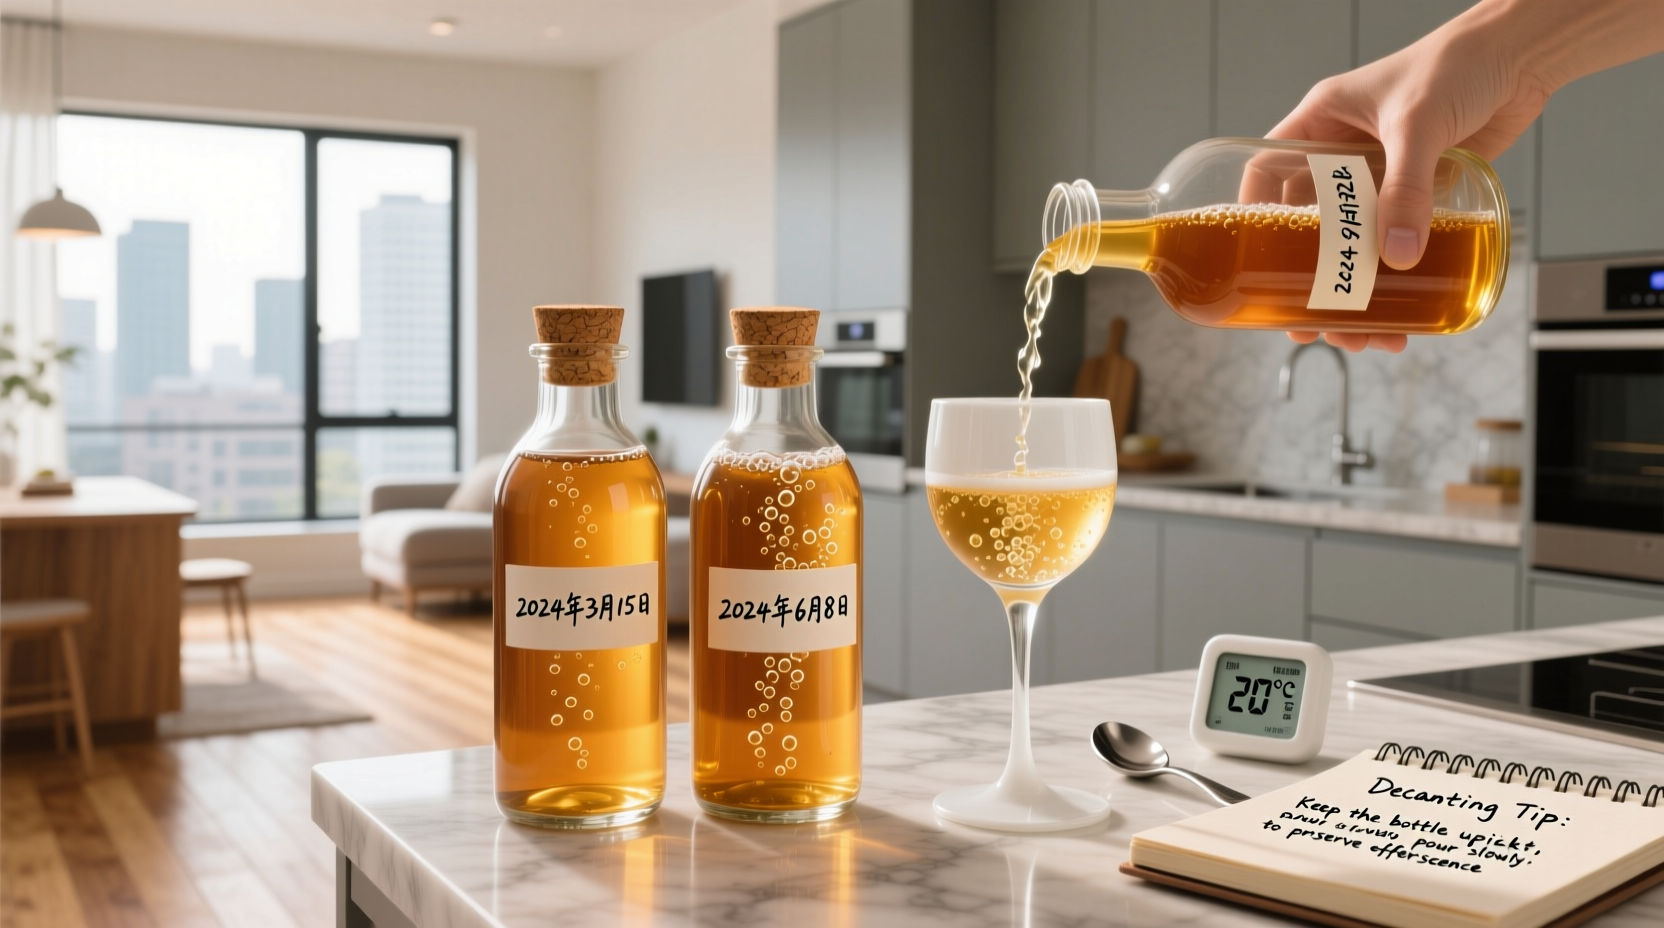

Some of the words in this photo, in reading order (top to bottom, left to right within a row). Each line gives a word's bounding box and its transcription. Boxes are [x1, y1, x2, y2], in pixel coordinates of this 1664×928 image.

[515, 591, 650, 627] 2024年3月15日
[718, 593, 848, 628] 2024年6月8日
[1295, 796, 1341, 820] Keep
[1349, 807, 1381, 823] the
[1388, 814, 1448, 836] bottle
[1367, 777, 1499, 823] Decanting
[1516, 802, 1571, 831] Tip:
[1262, 819, 1282, 832] to
[1410, 838, 1459, 853] pour
